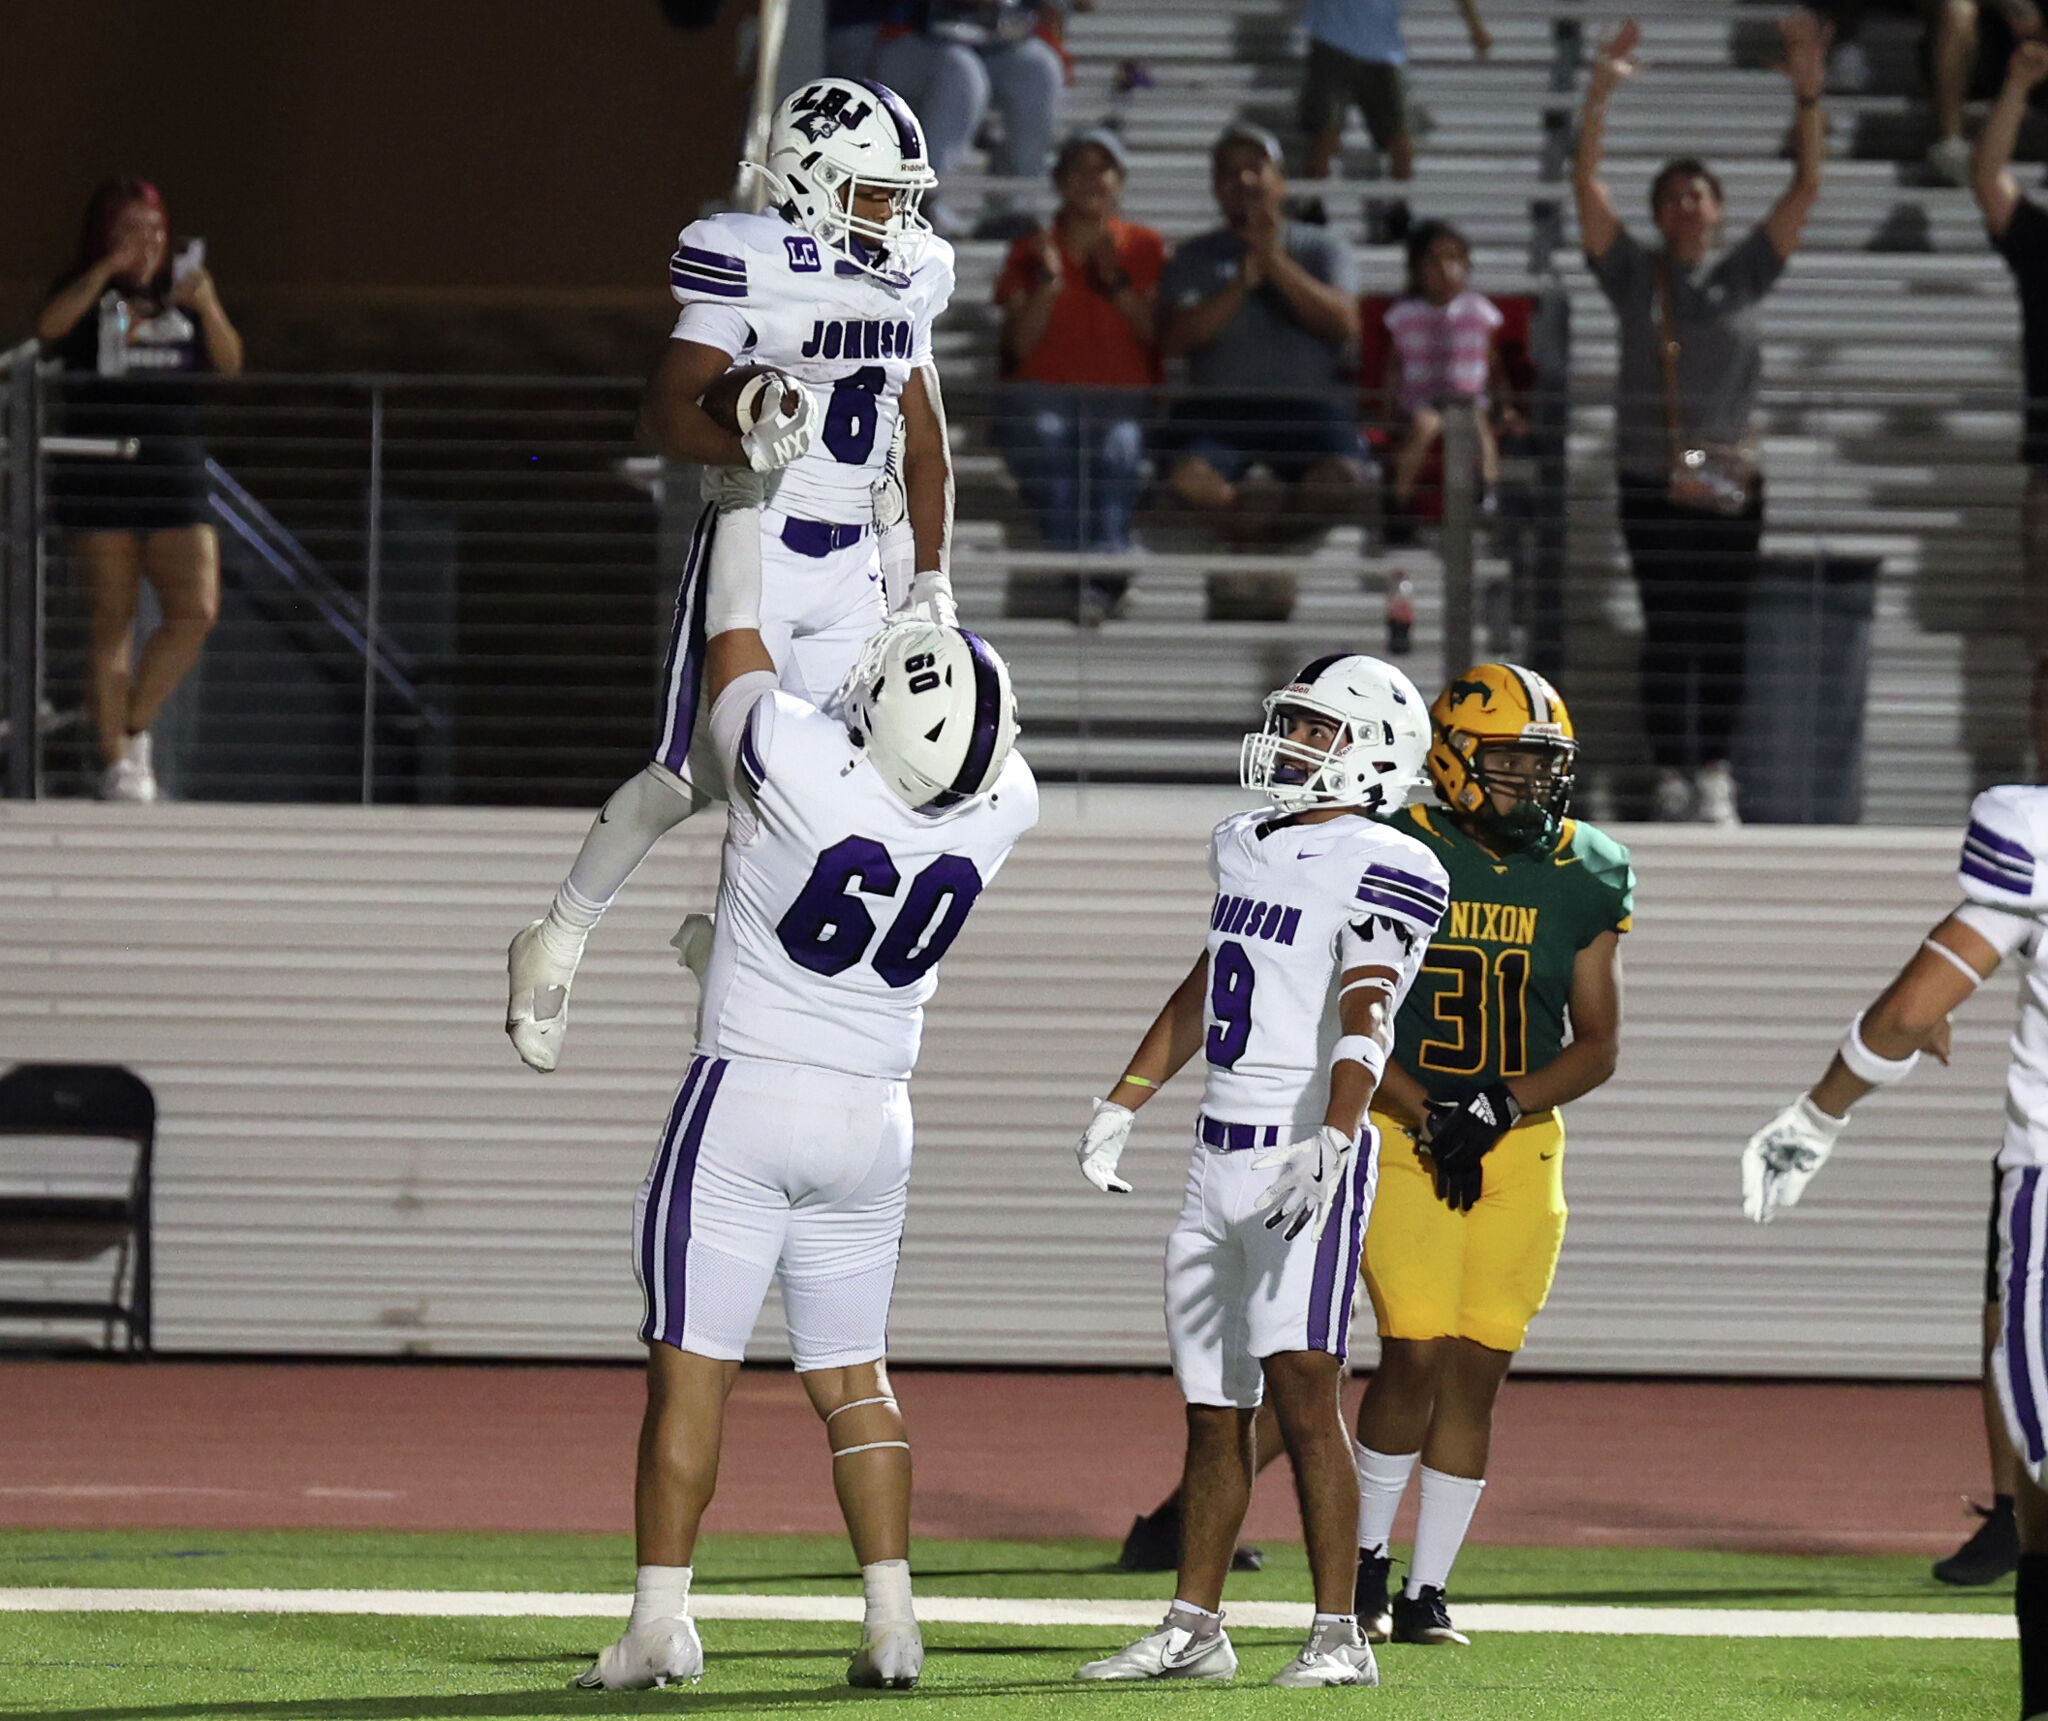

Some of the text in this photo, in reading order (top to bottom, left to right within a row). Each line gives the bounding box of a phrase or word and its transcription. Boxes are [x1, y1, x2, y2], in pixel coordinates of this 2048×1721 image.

[791, 86, 873, 130] LBJ
[790, 242, 817, 266] LC
[905, 653, 940, 694] 60
[775, 834, 983, 988] 60
[1211, 893, 1302, 946] OHNSON
[1449, 901, 1538, 944] NIXON
[1206, 940, 1255, 1071] 9
[1419, 944, 1530, 1077] 31
